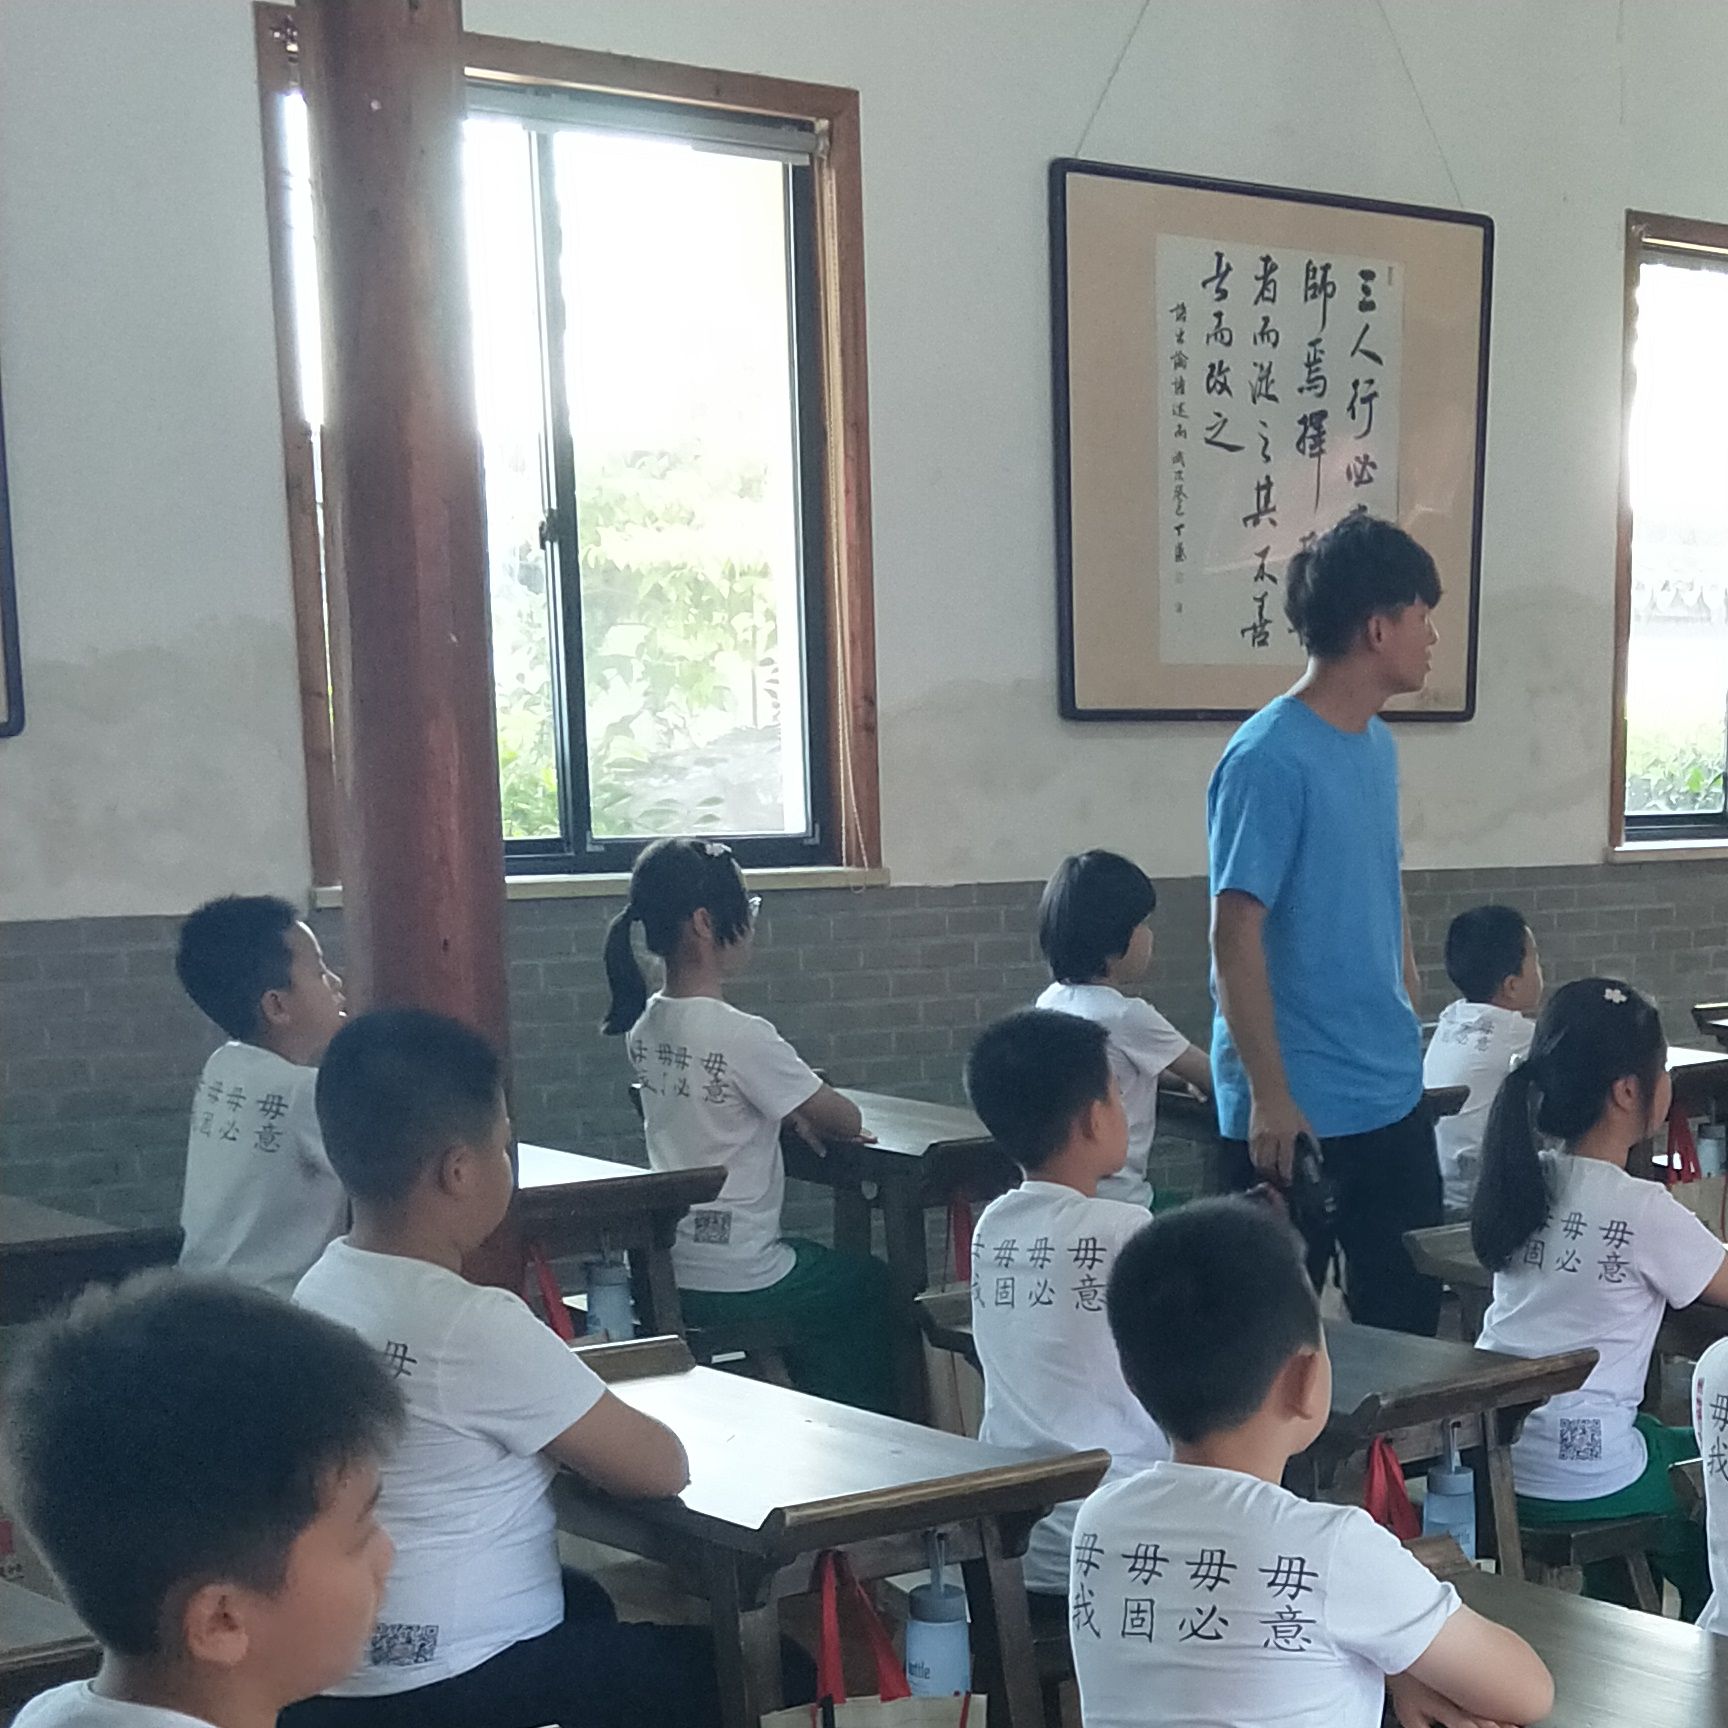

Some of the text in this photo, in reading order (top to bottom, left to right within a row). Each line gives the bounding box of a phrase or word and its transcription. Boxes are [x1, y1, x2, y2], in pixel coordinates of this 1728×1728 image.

[1296, 258, 1337, 549] 師焉擇
[1346, 268, 1384, 516] 三人行必
